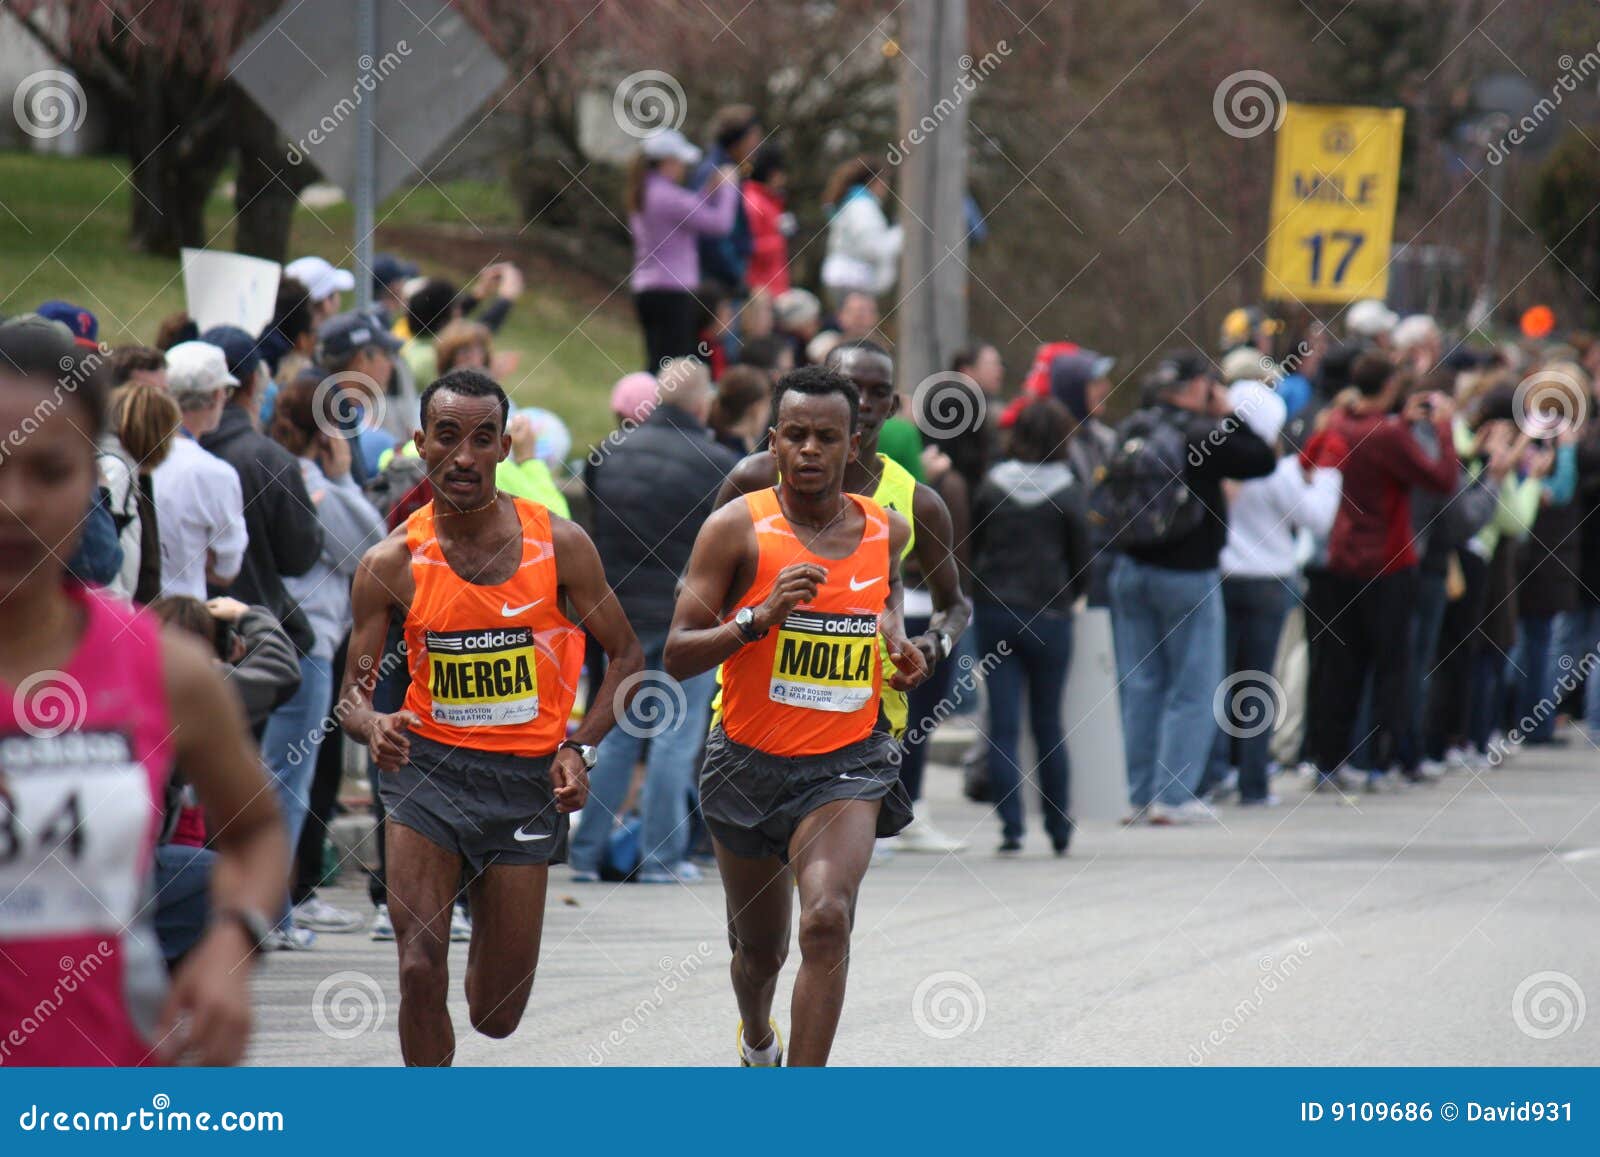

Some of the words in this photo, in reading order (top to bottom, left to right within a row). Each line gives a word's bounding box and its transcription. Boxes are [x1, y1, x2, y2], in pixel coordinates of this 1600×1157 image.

[1293, 171, 1379, 209] MILE
[1301, 230, 1366, 287] 17
[825, 618, 876, 634] adidas
[464, 631, 528, 649] adidas
[779, 638, 871, 681] MOLLA
[432, 655, 533, 699] MERGA
[789, 692, 832, 703] MARATHON
[807, 687, 832, 696] BOSTON
[448, 713, 493, 721] MARATHON
